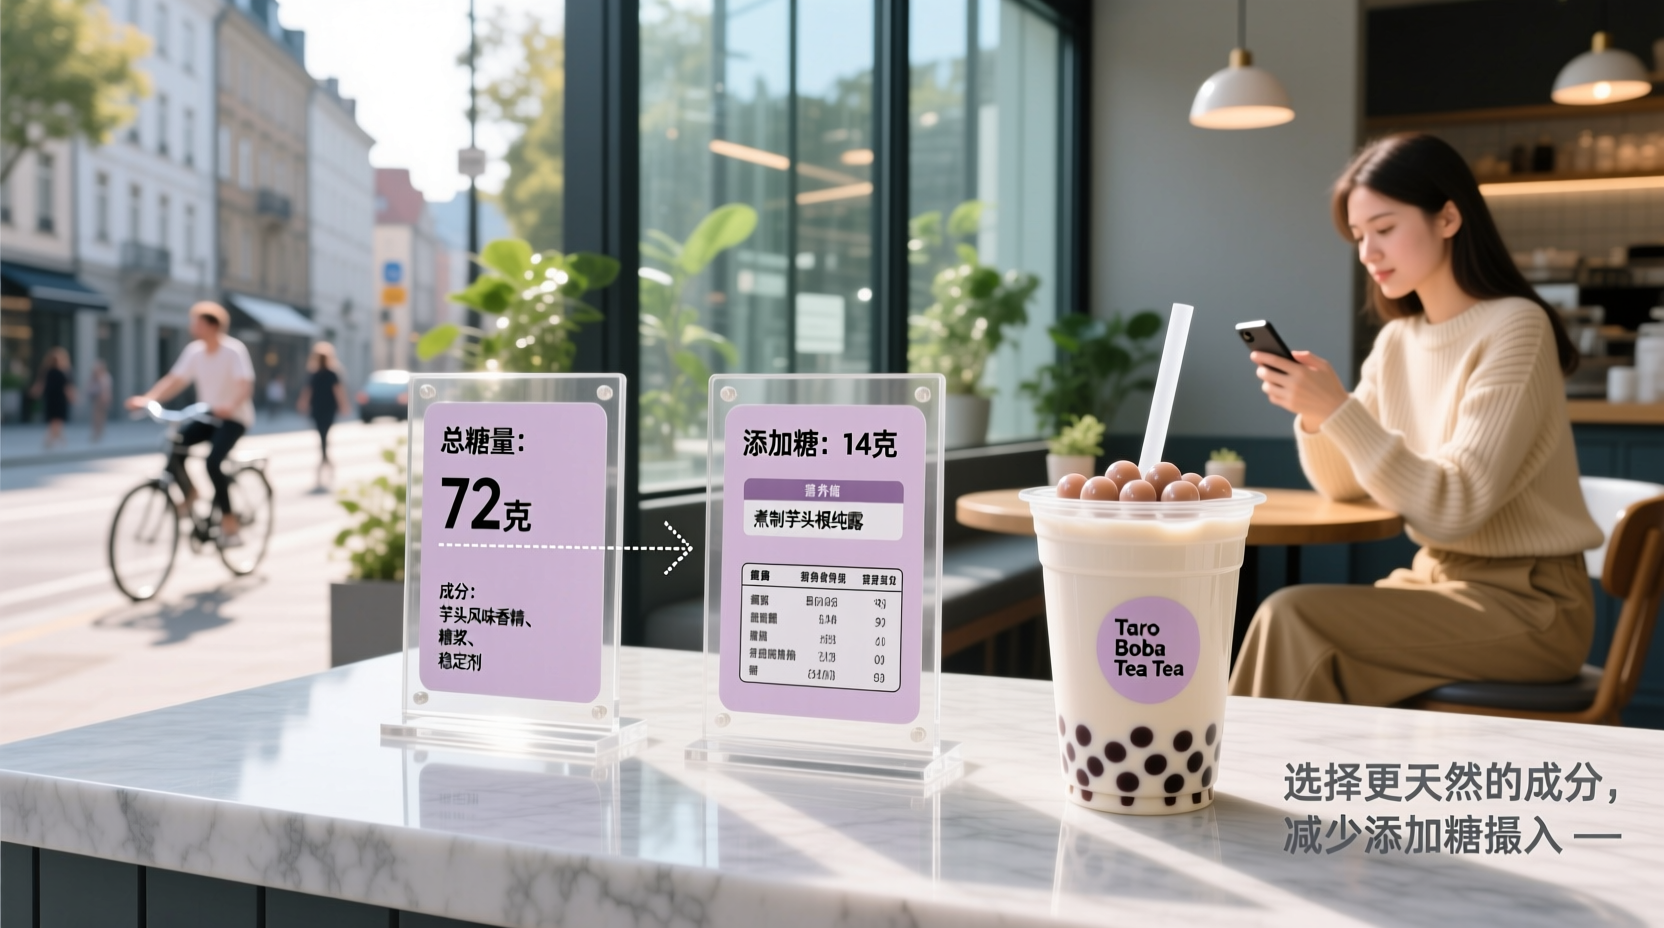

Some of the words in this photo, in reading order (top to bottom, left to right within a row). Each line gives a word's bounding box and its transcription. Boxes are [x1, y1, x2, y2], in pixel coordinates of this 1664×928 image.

[441, 426, 524, 455] 总糖量：
[441, 477, 532, 532] 72克
[439, 582, 475, 600] 成分：
[1114, 618, 1160, 636] Taro
[1115, 638, 1166, 657] Boba
[438, 651, 482, 672] 稳定剂
[1113, 659, 1148, 678] Tea
[1152, 660, 1184, 677] Tea
